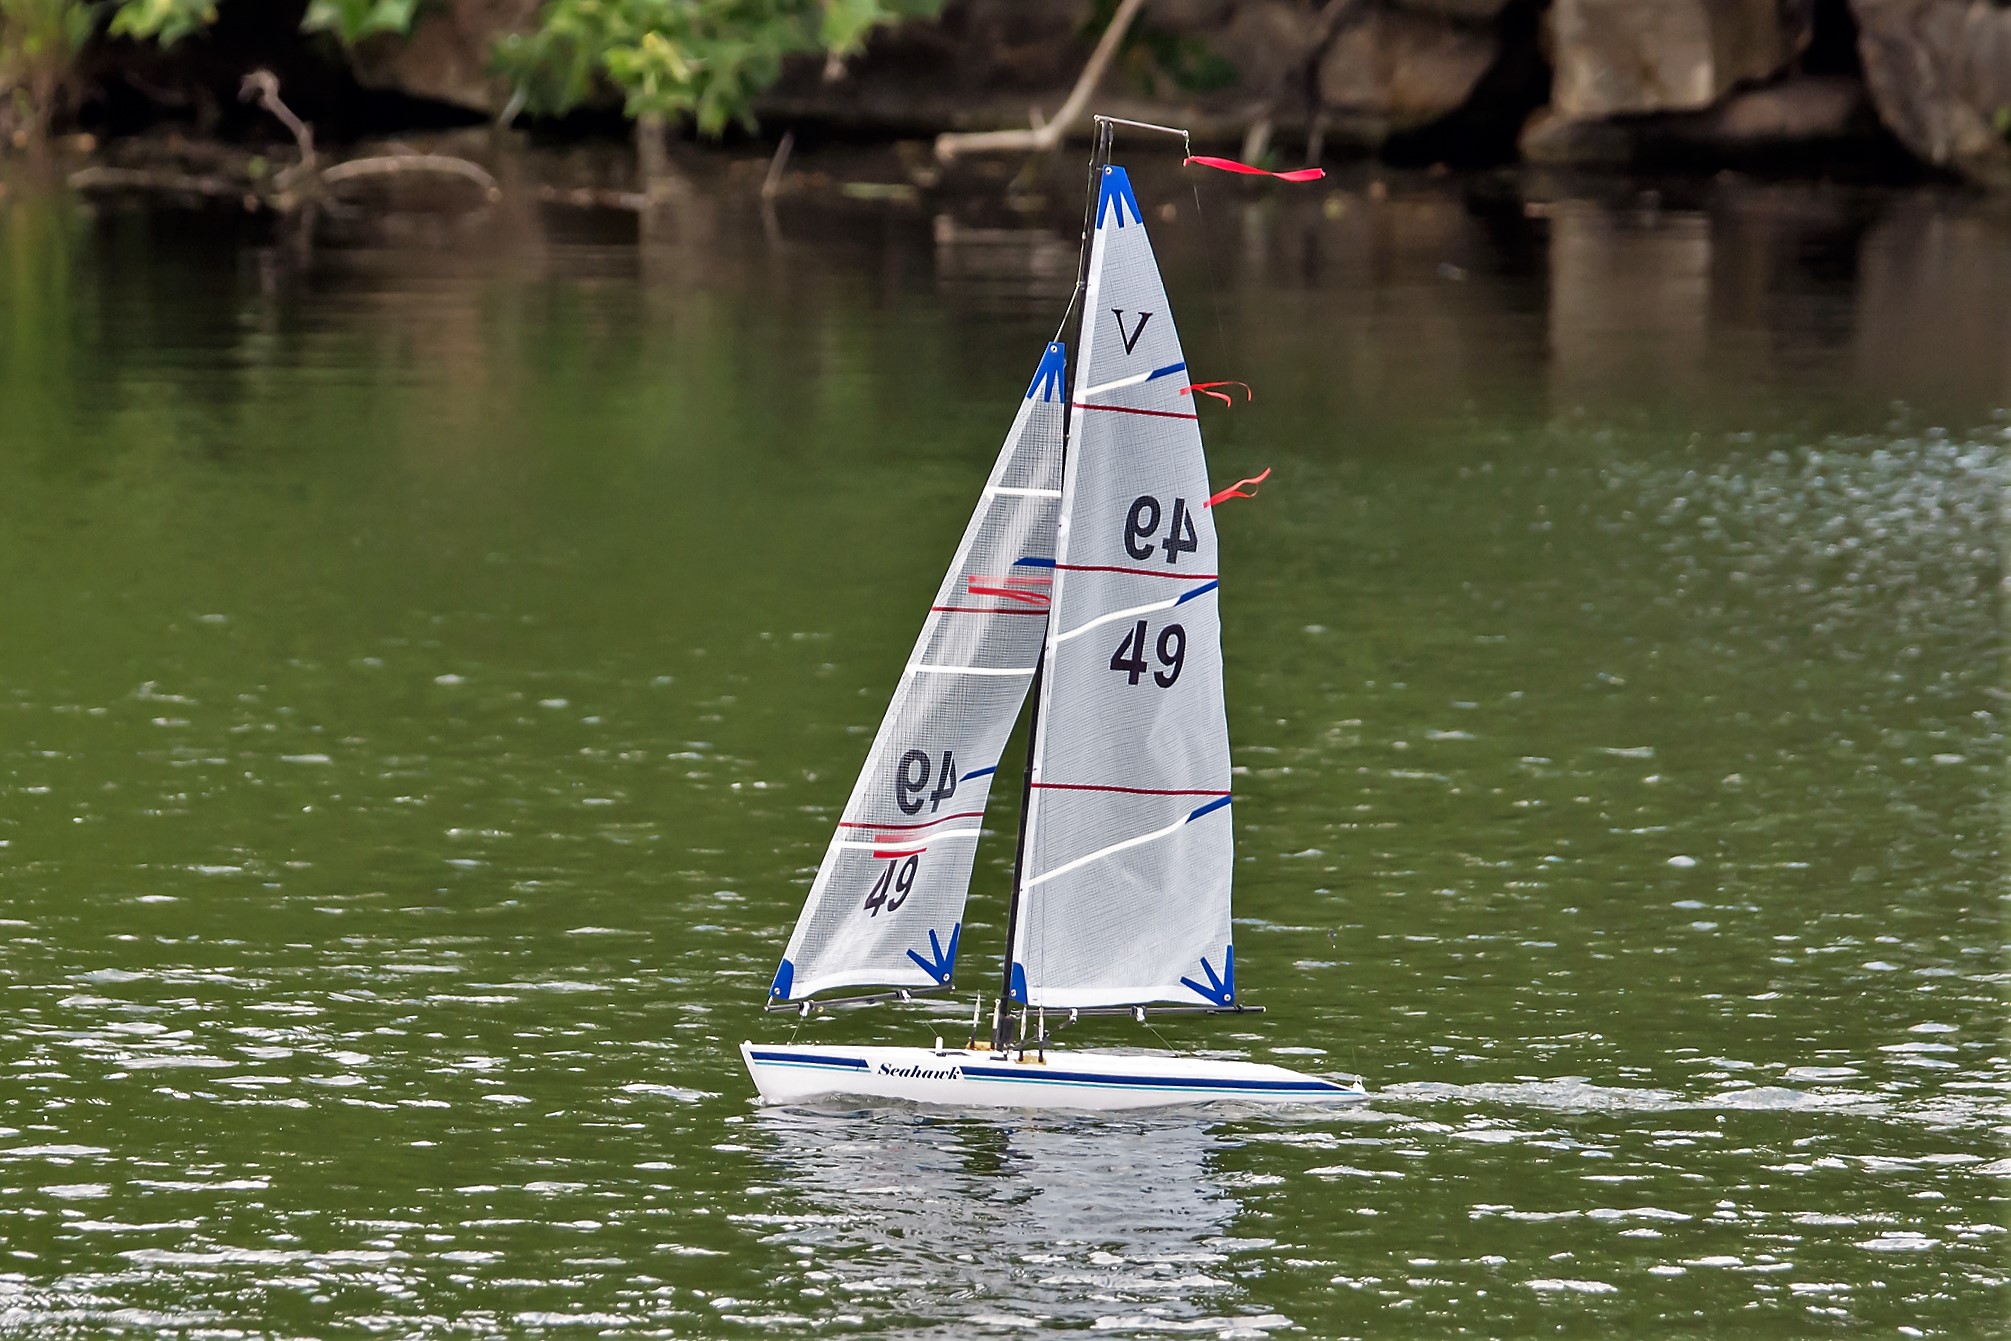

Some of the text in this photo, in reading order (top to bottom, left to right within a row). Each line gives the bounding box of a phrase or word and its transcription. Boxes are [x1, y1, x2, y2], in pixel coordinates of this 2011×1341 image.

[1111, 309, 1153, 355] V
[1110, 620, 1187, 689] 49
[863, 854, 919, 917] 49
[877, 1062, 960, 1080] Seahawk
